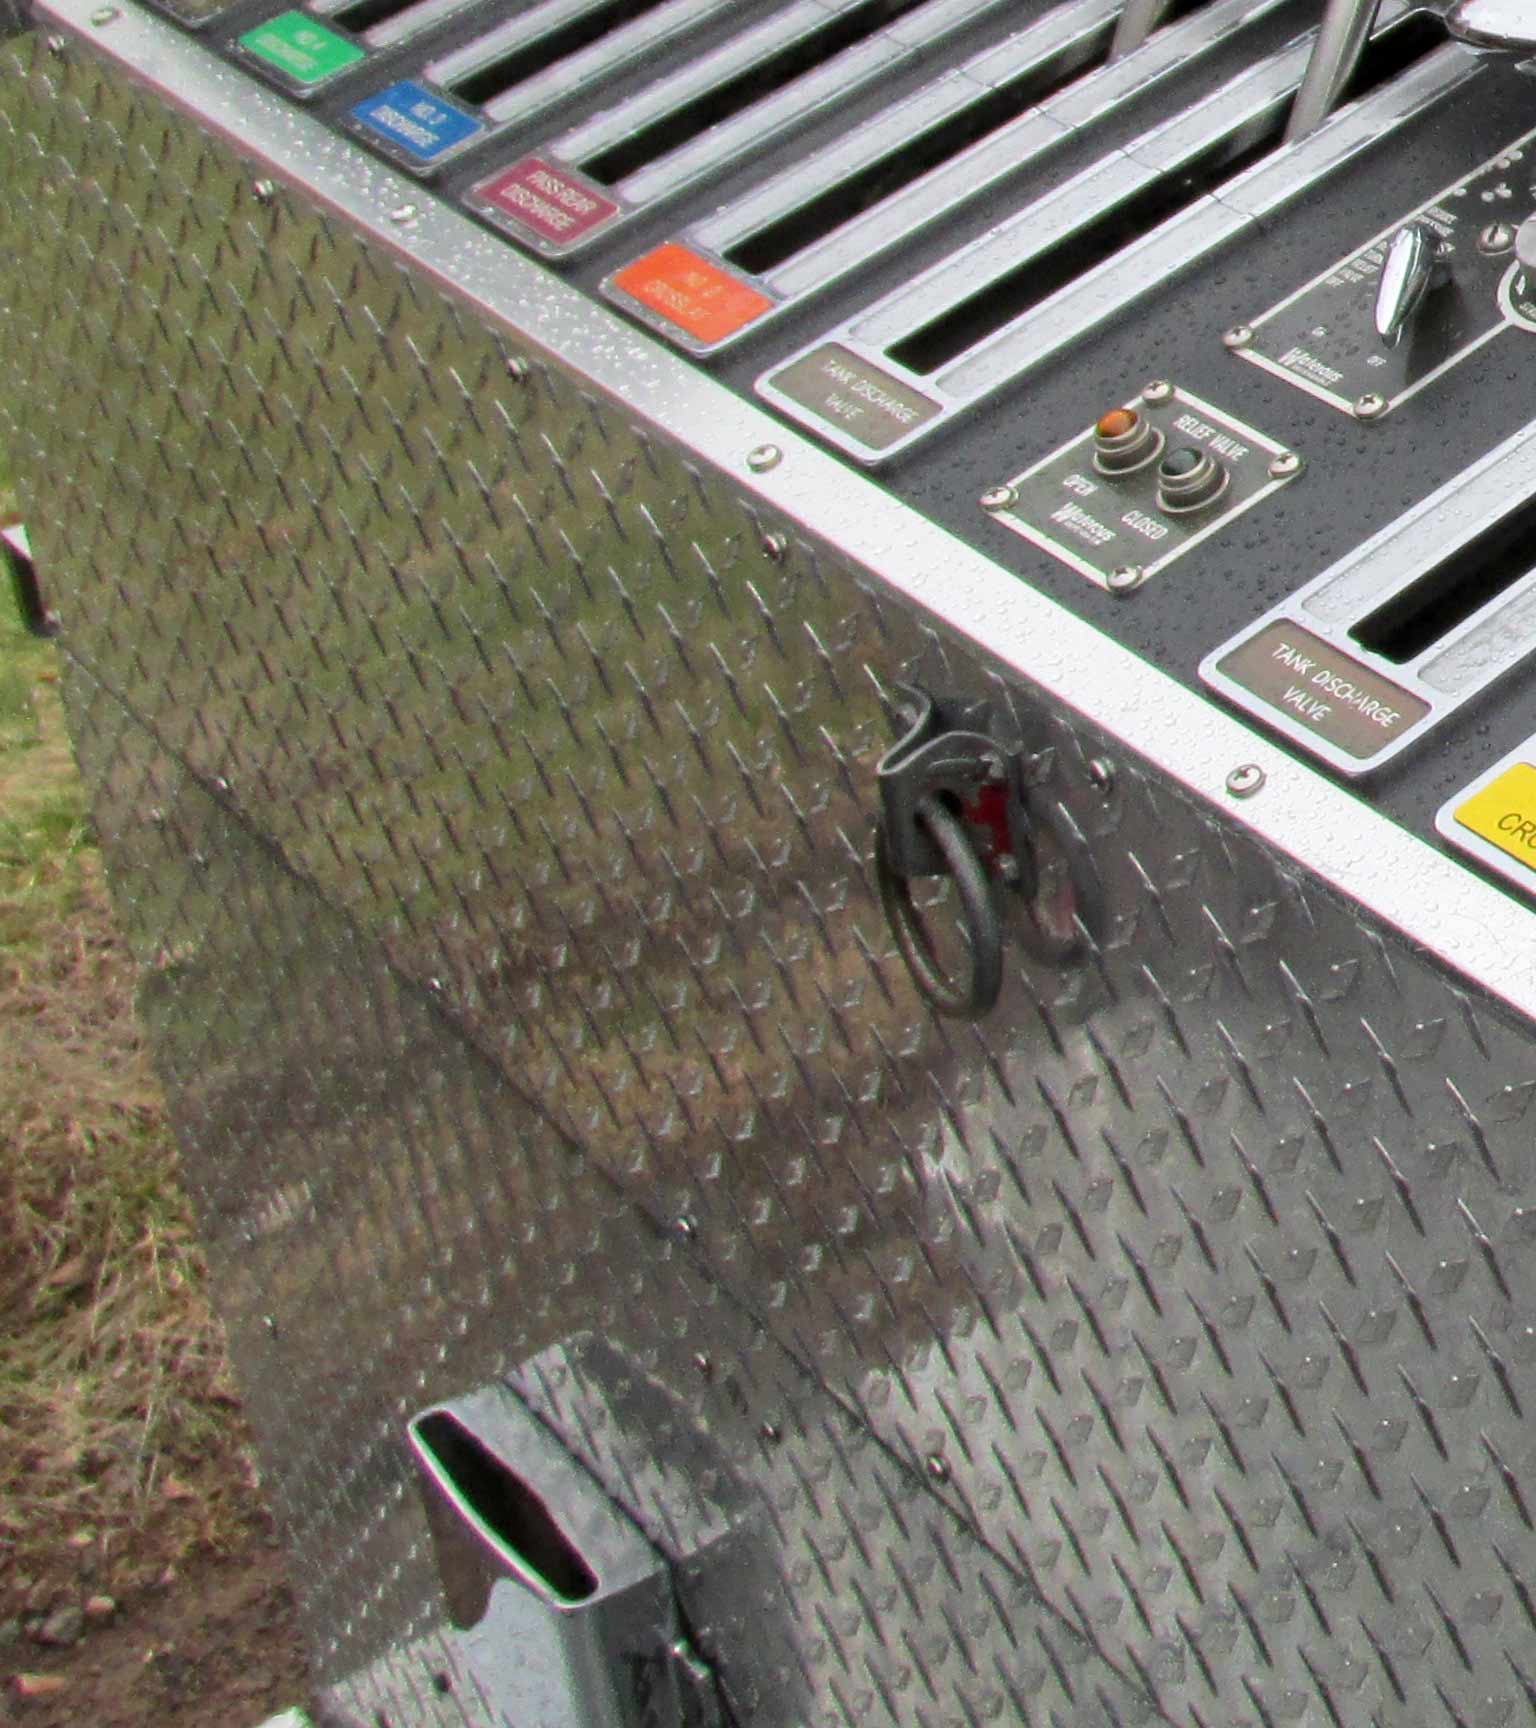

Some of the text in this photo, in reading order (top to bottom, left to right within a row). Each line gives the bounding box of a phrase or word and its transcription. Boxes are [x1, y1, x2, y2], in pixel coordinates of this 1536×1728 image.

[825, 393, 864, 419] VALVE
[851, 379, 919, 424] DISCHARGE
[1173, 414, 1250, 462] RELIEF VALVE
[1062, 473, 1099, 496] OPEN
[1120, 509, 1168, 540] CLOSED
[1269, 640, 1402, 730] TANK DISCHARGE
[1279, 683, 1334, 725] VALVE
